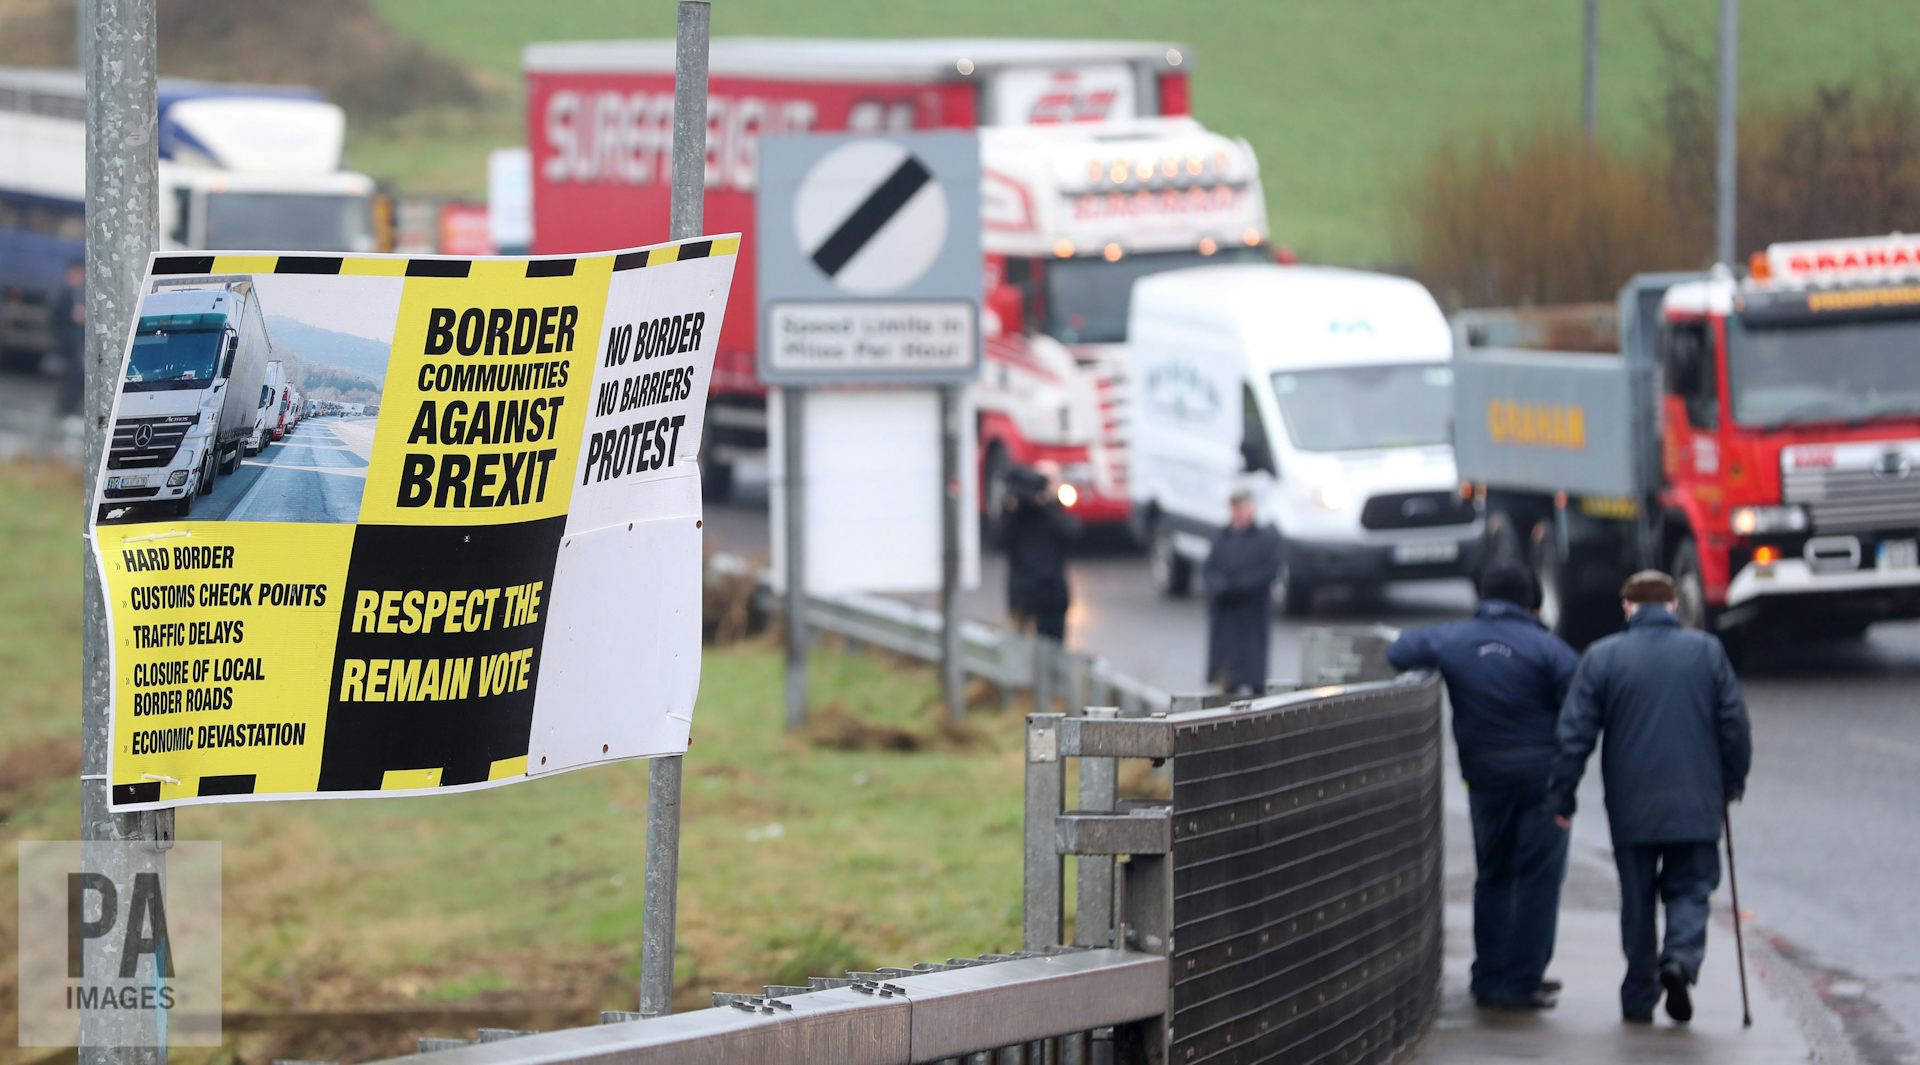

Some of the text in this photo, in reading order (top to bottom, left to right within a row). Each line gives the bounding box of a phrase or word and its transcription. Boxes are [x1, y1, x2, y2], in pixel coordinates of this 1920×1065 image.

[1788, 249, 1920, 273] GRAHA
[424, 306, 578, 356] BORDER
[605, 312, 704, 367] NO BORDER
[418, 361, 569, 391] COMMUNITIES
[596, 366, 693, 417] NO BARRIERS
[407, 396, 564, 445] AGAINST
[1487, 399, 1586, 449] GRAHAM
[583, 415, 685, 485] PROTEST
[397, 449, 557, 508] BREXIT
[123, 546, 234, 571] HARD BORDER
[132, 583, 326, 610] CUSTOMS CHECK POINTS
[352, 581, 543, 633] RESPECT THE
[133, 621, 243, 648] TRAFFIC DELAYS
[134, 658, 264, 687] CLOSURE OF LOCAL
[340, 648, 533, 701] REMAIN VOTE
[134, 687, 232, 716] BORDER ROADS
[133, 723, 305, 754] ECONOMIC DEVASTATION
